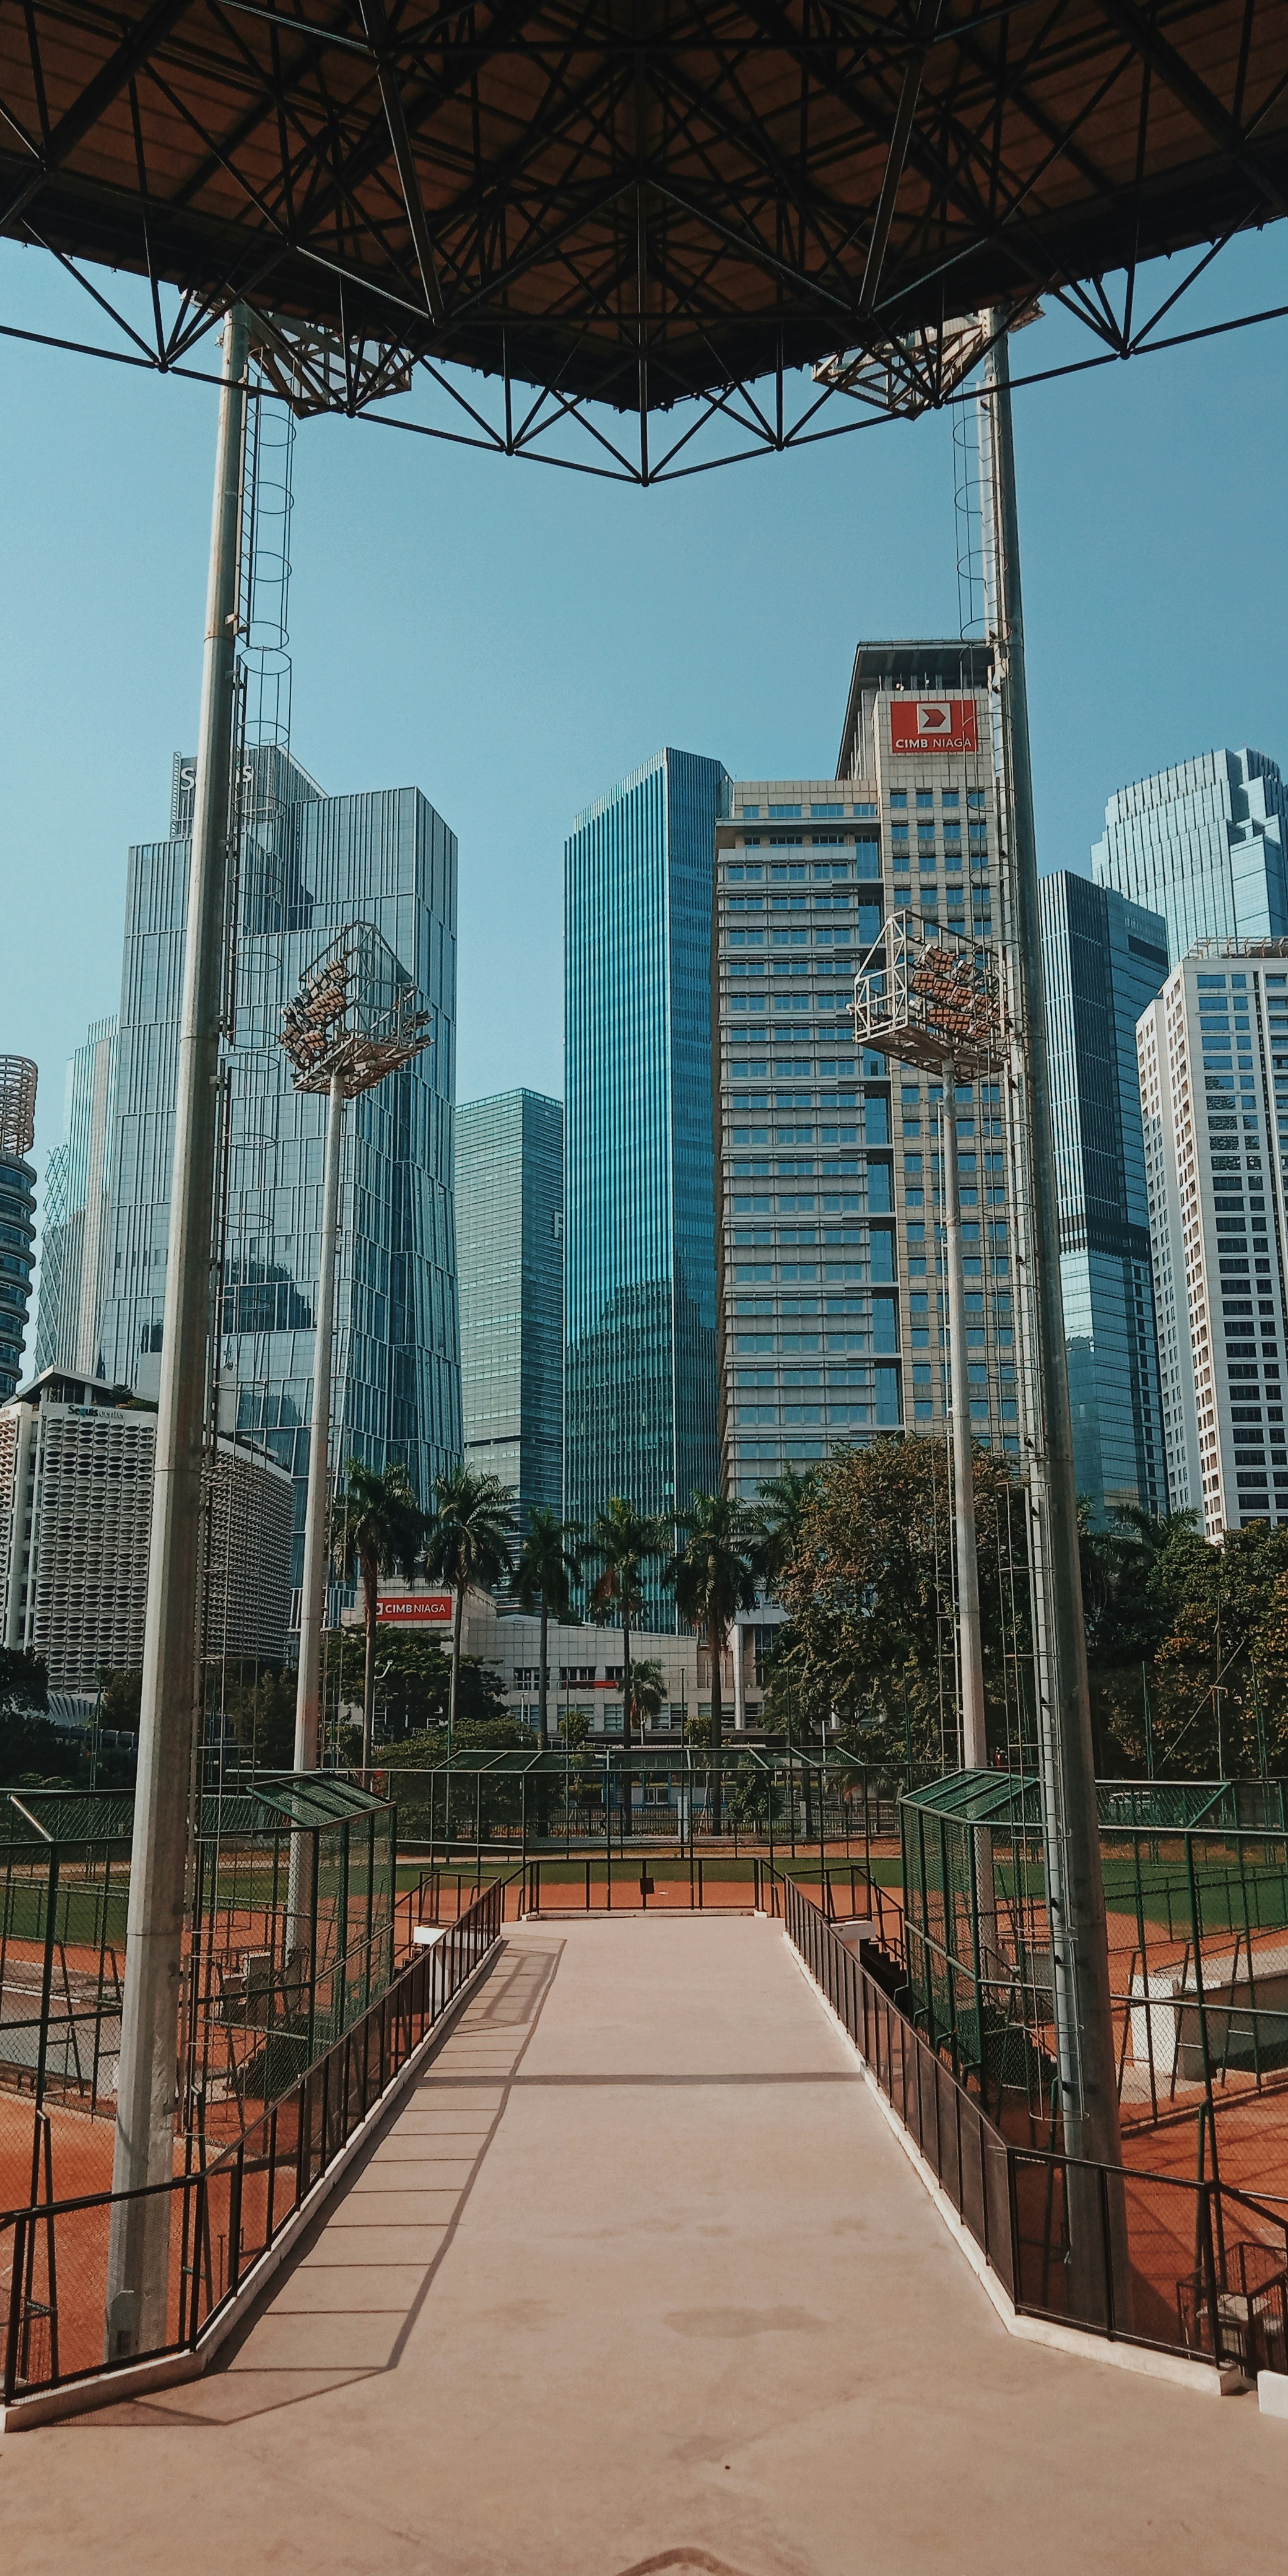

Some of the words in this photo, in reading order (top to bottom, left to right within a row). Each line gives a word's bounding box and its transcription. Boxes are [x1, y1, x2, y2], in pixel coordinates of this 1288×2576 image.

[895, 739, 928, 749] CIMB
[933, 738, 972, 748] NIAGA
[67, 1404, 98, 1417] Sequis
[385, 1604, 412, 1613] CIMB
[414, 1604, 446, 1613] NIAGA
